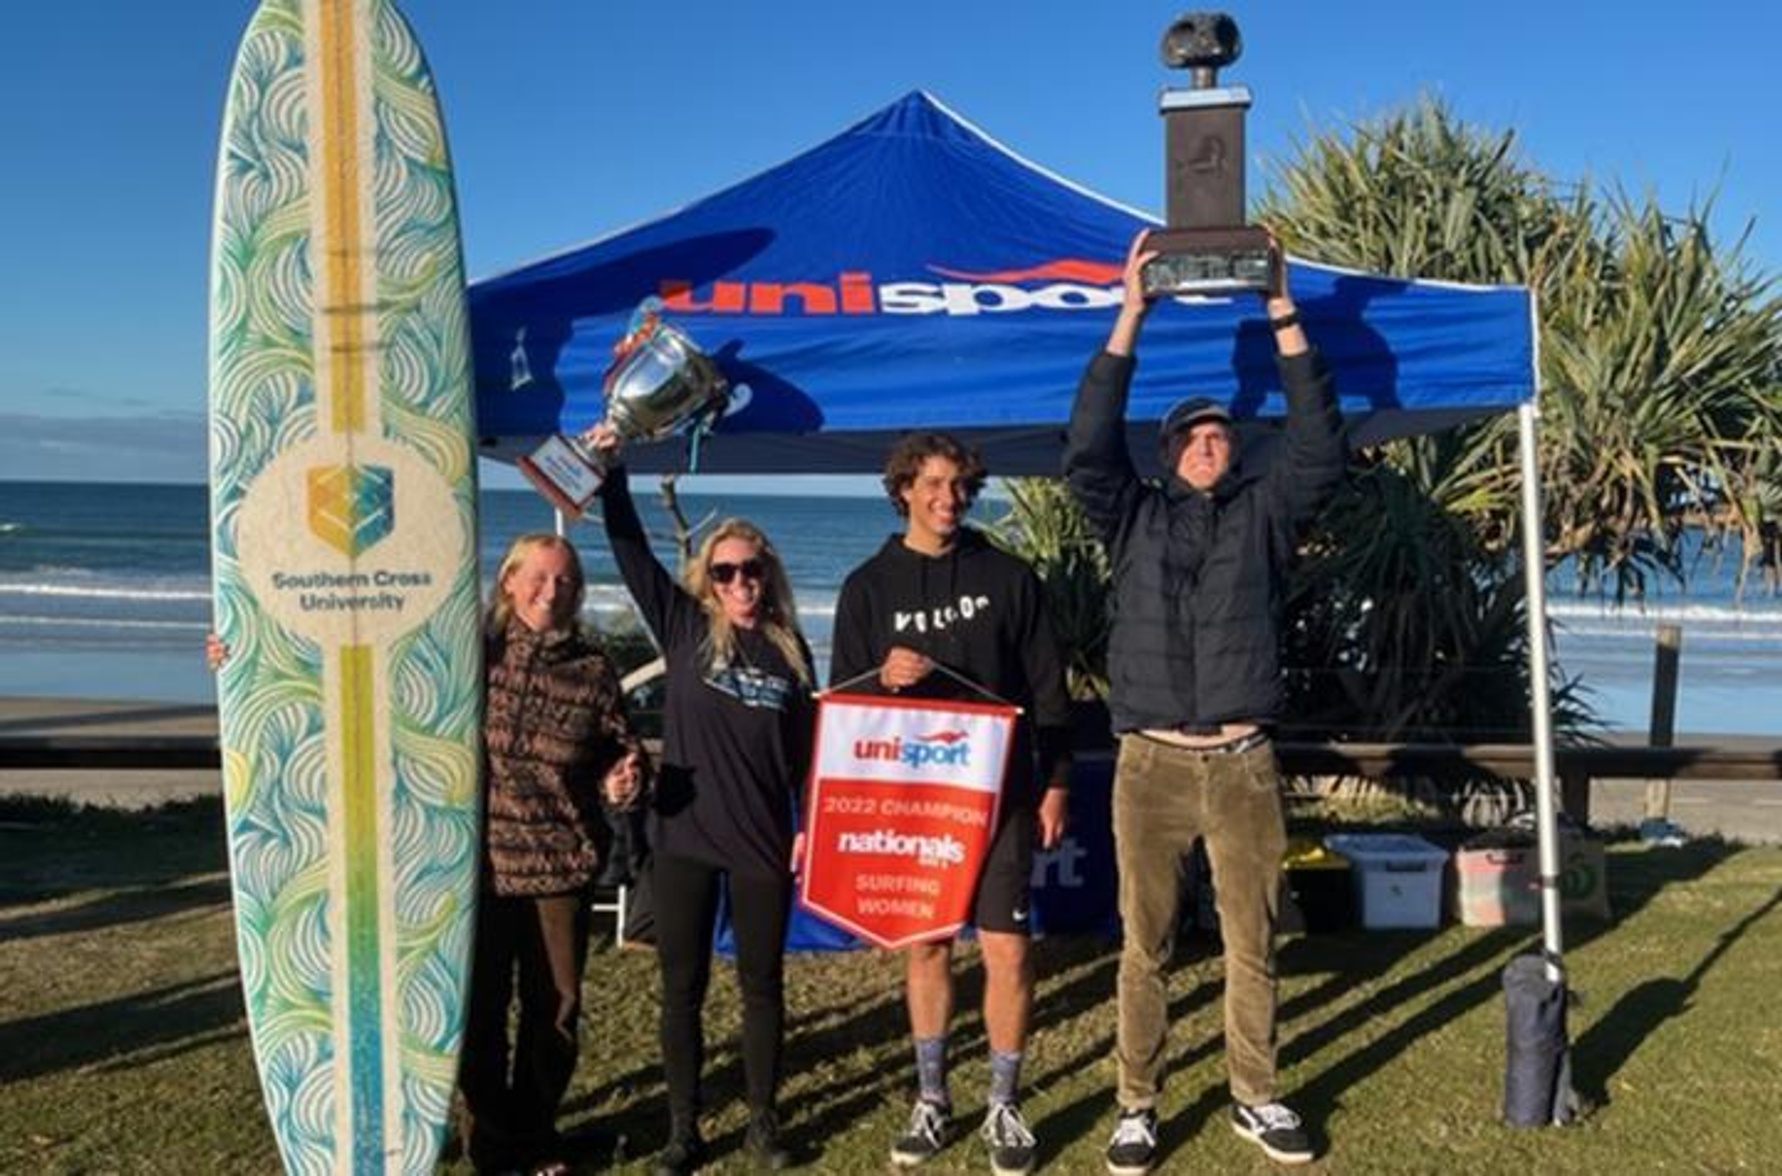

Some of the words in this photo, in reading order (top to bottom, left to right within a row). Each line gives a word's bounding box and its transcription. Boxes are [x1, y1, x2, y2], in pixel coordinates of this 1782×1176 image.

[660, 271, 1233, 316] unispo
[272, 572, 370, 588] Southern
[373, 571, 432, 587] Cross
[299, 594, 405, 611] University
[854, 738, 971, 768] unisport
[824, 797, 876, 814] 2022
[880, 801, 988, 827] CHAMPION
[838, 829, 966, 864] nationals
[857, 898, 935, 919] WOMEN
